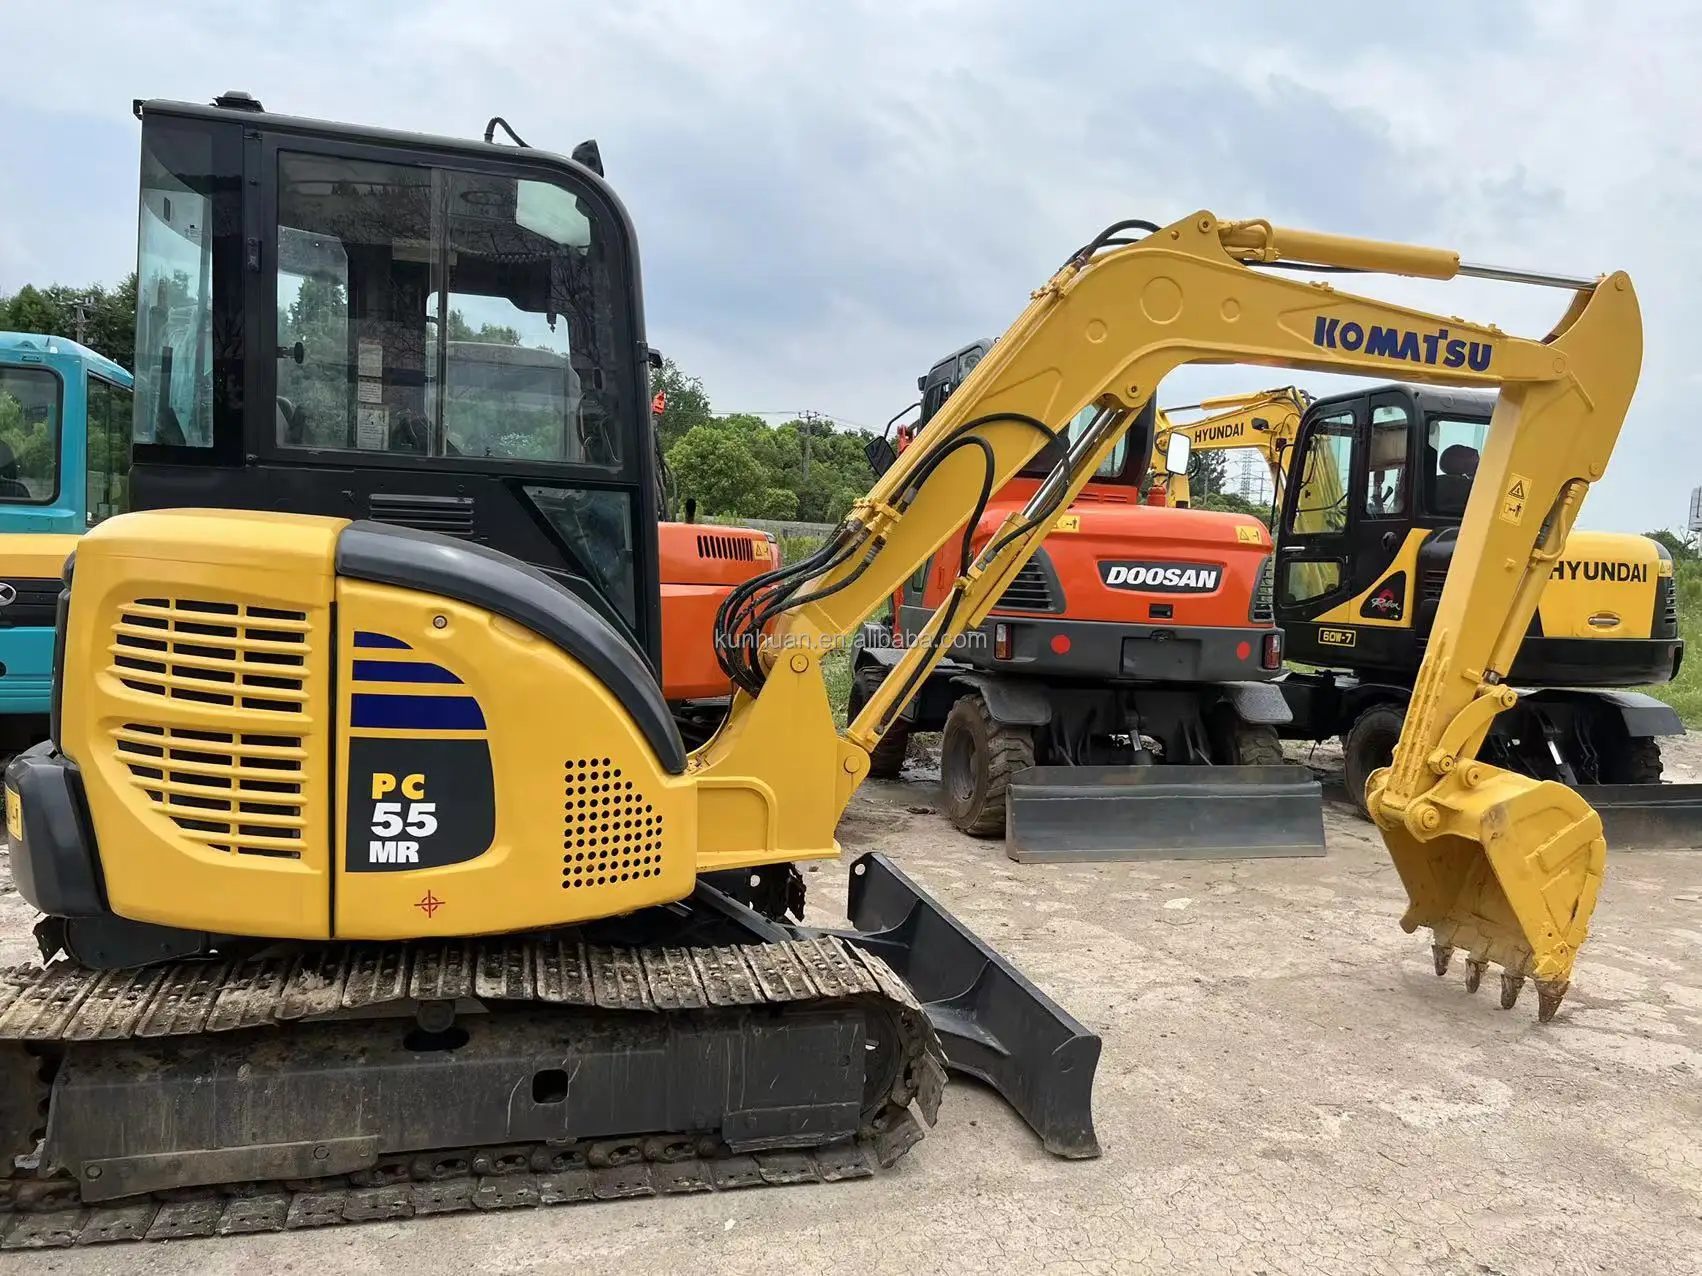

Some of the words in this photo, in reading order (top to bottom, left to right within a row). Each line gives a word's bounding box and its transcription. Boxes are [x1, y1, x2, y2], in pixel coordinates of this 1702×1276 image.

[1314, 316, 1493, 372] KOMATSU
[1194, 422, 1244, 444] HYUNDAI
[1106, 566, 1217, 589] DOOSAN
[1323, 631, 1352, 644] 60W-7
[371, 773, 425, 800] PC
[370, 803, 438, 838] 55
[369, 841, 420, 864] MR
